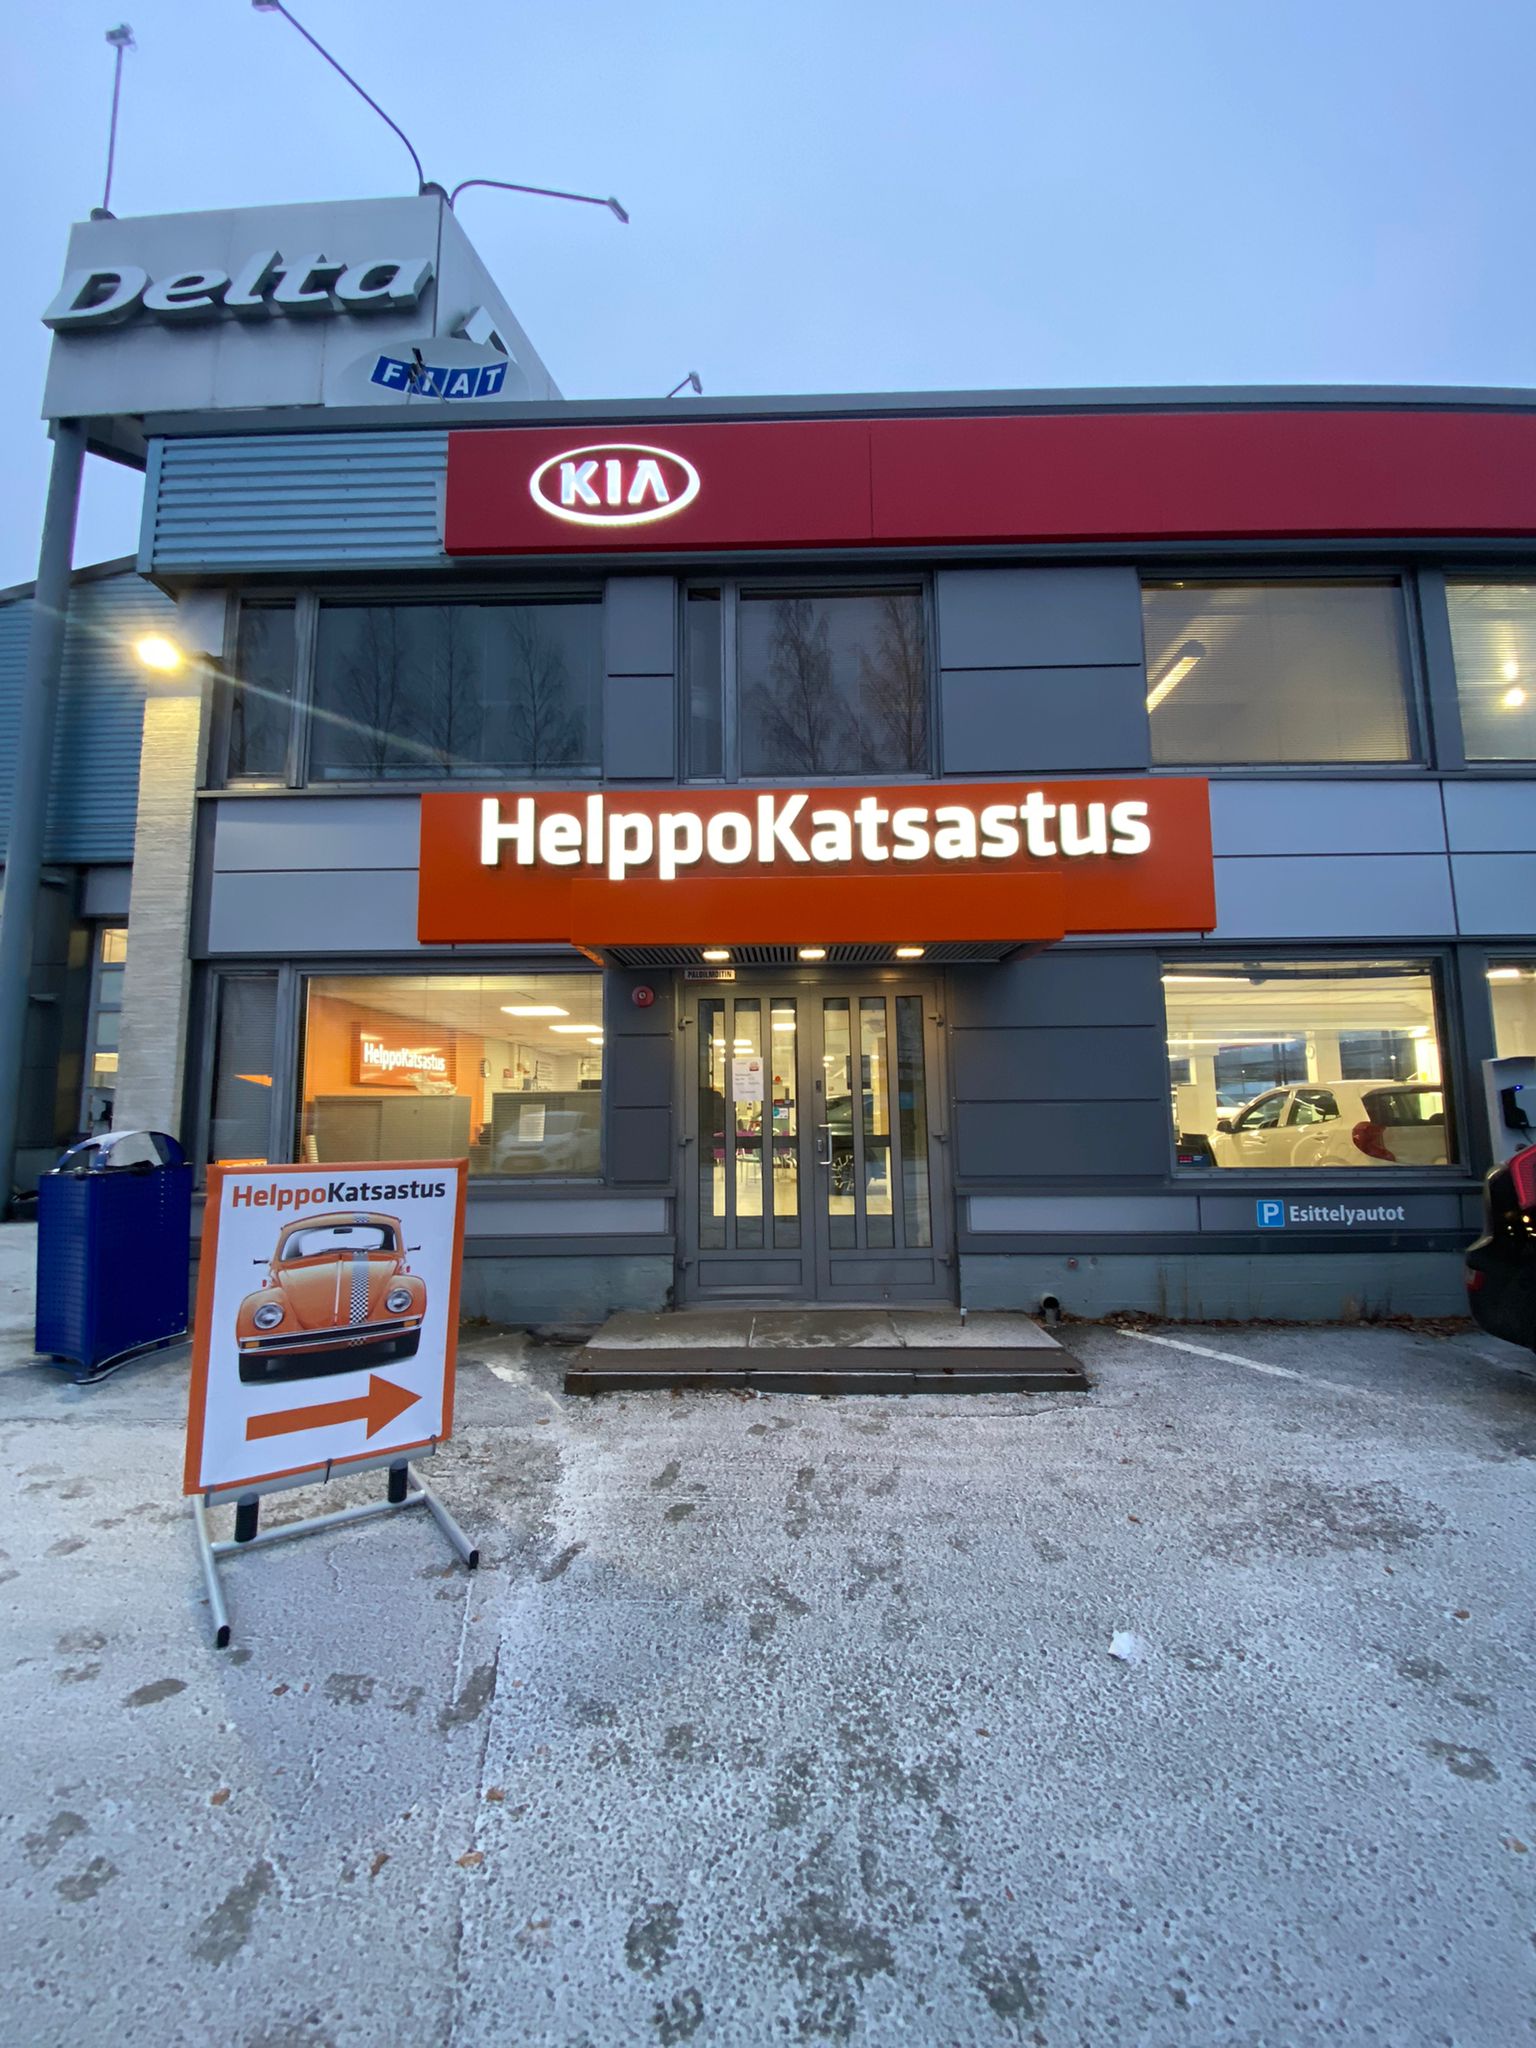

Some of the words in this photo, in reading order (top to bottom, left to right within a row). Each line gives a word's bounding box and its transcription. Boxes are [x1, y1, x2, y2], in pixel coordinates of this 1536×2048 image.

[44, 250, 432, 328] Delta
[382, 363, 502, 395] FIAT
[560, 459, 670, 505] KIA
[480, 792, 1151, 881] HelppoKatsastus
[363, 1042, 446, 1071] HelppoKatsastus
[232, 1181, 446, 1211] HelppoKatsastus
[1263, 1203, 1279, 1223] P
[1289, 1205, 1405, 1225] Esittelyautot
